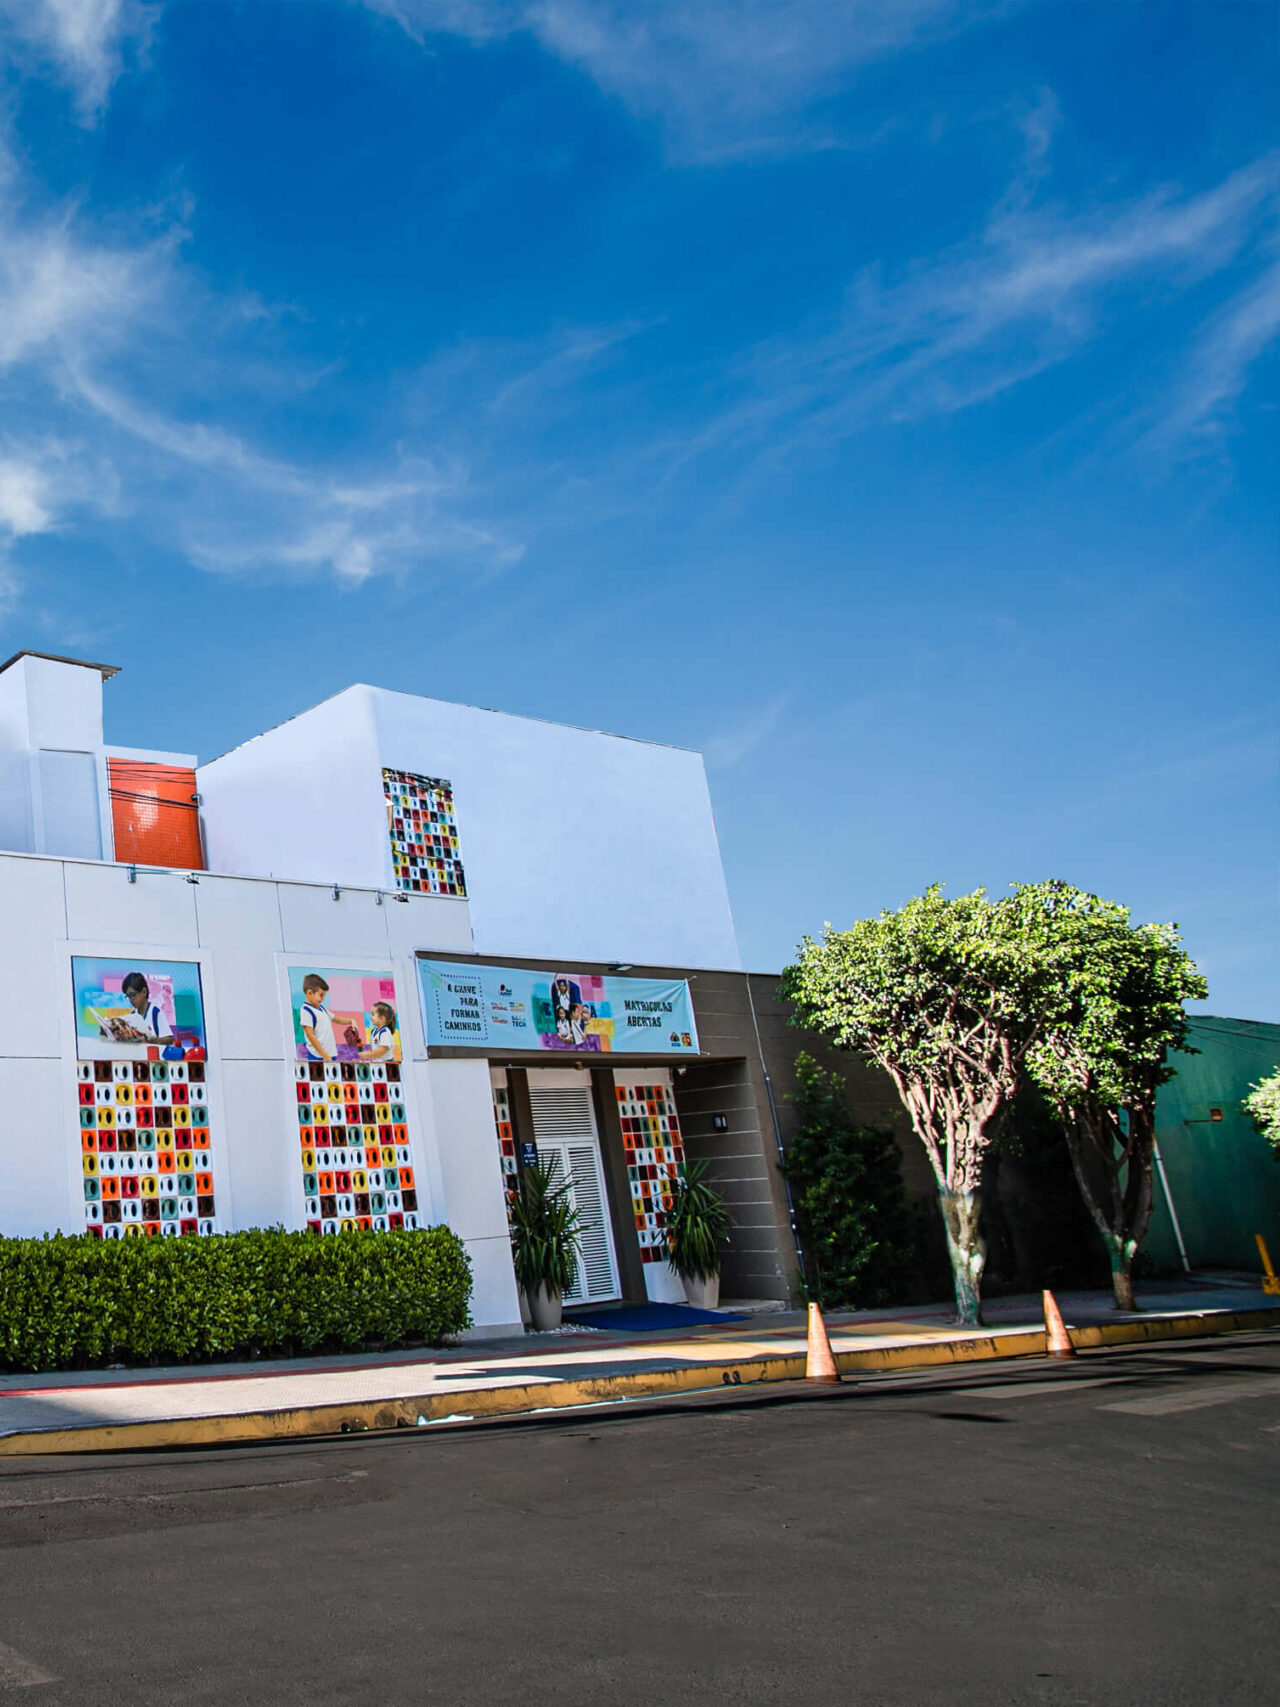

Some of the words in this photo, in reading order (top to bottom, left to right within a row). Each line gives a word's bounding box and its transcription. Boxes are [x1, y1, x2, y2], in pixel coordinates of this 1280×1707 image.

[460, 997, 478, 1006] PARA
[451, 1008, 480, 1018] FORMAR
[444, 1020, 481, 1031] CAMINHOS
[627, 1015, 662, 1028] ABERTAS
